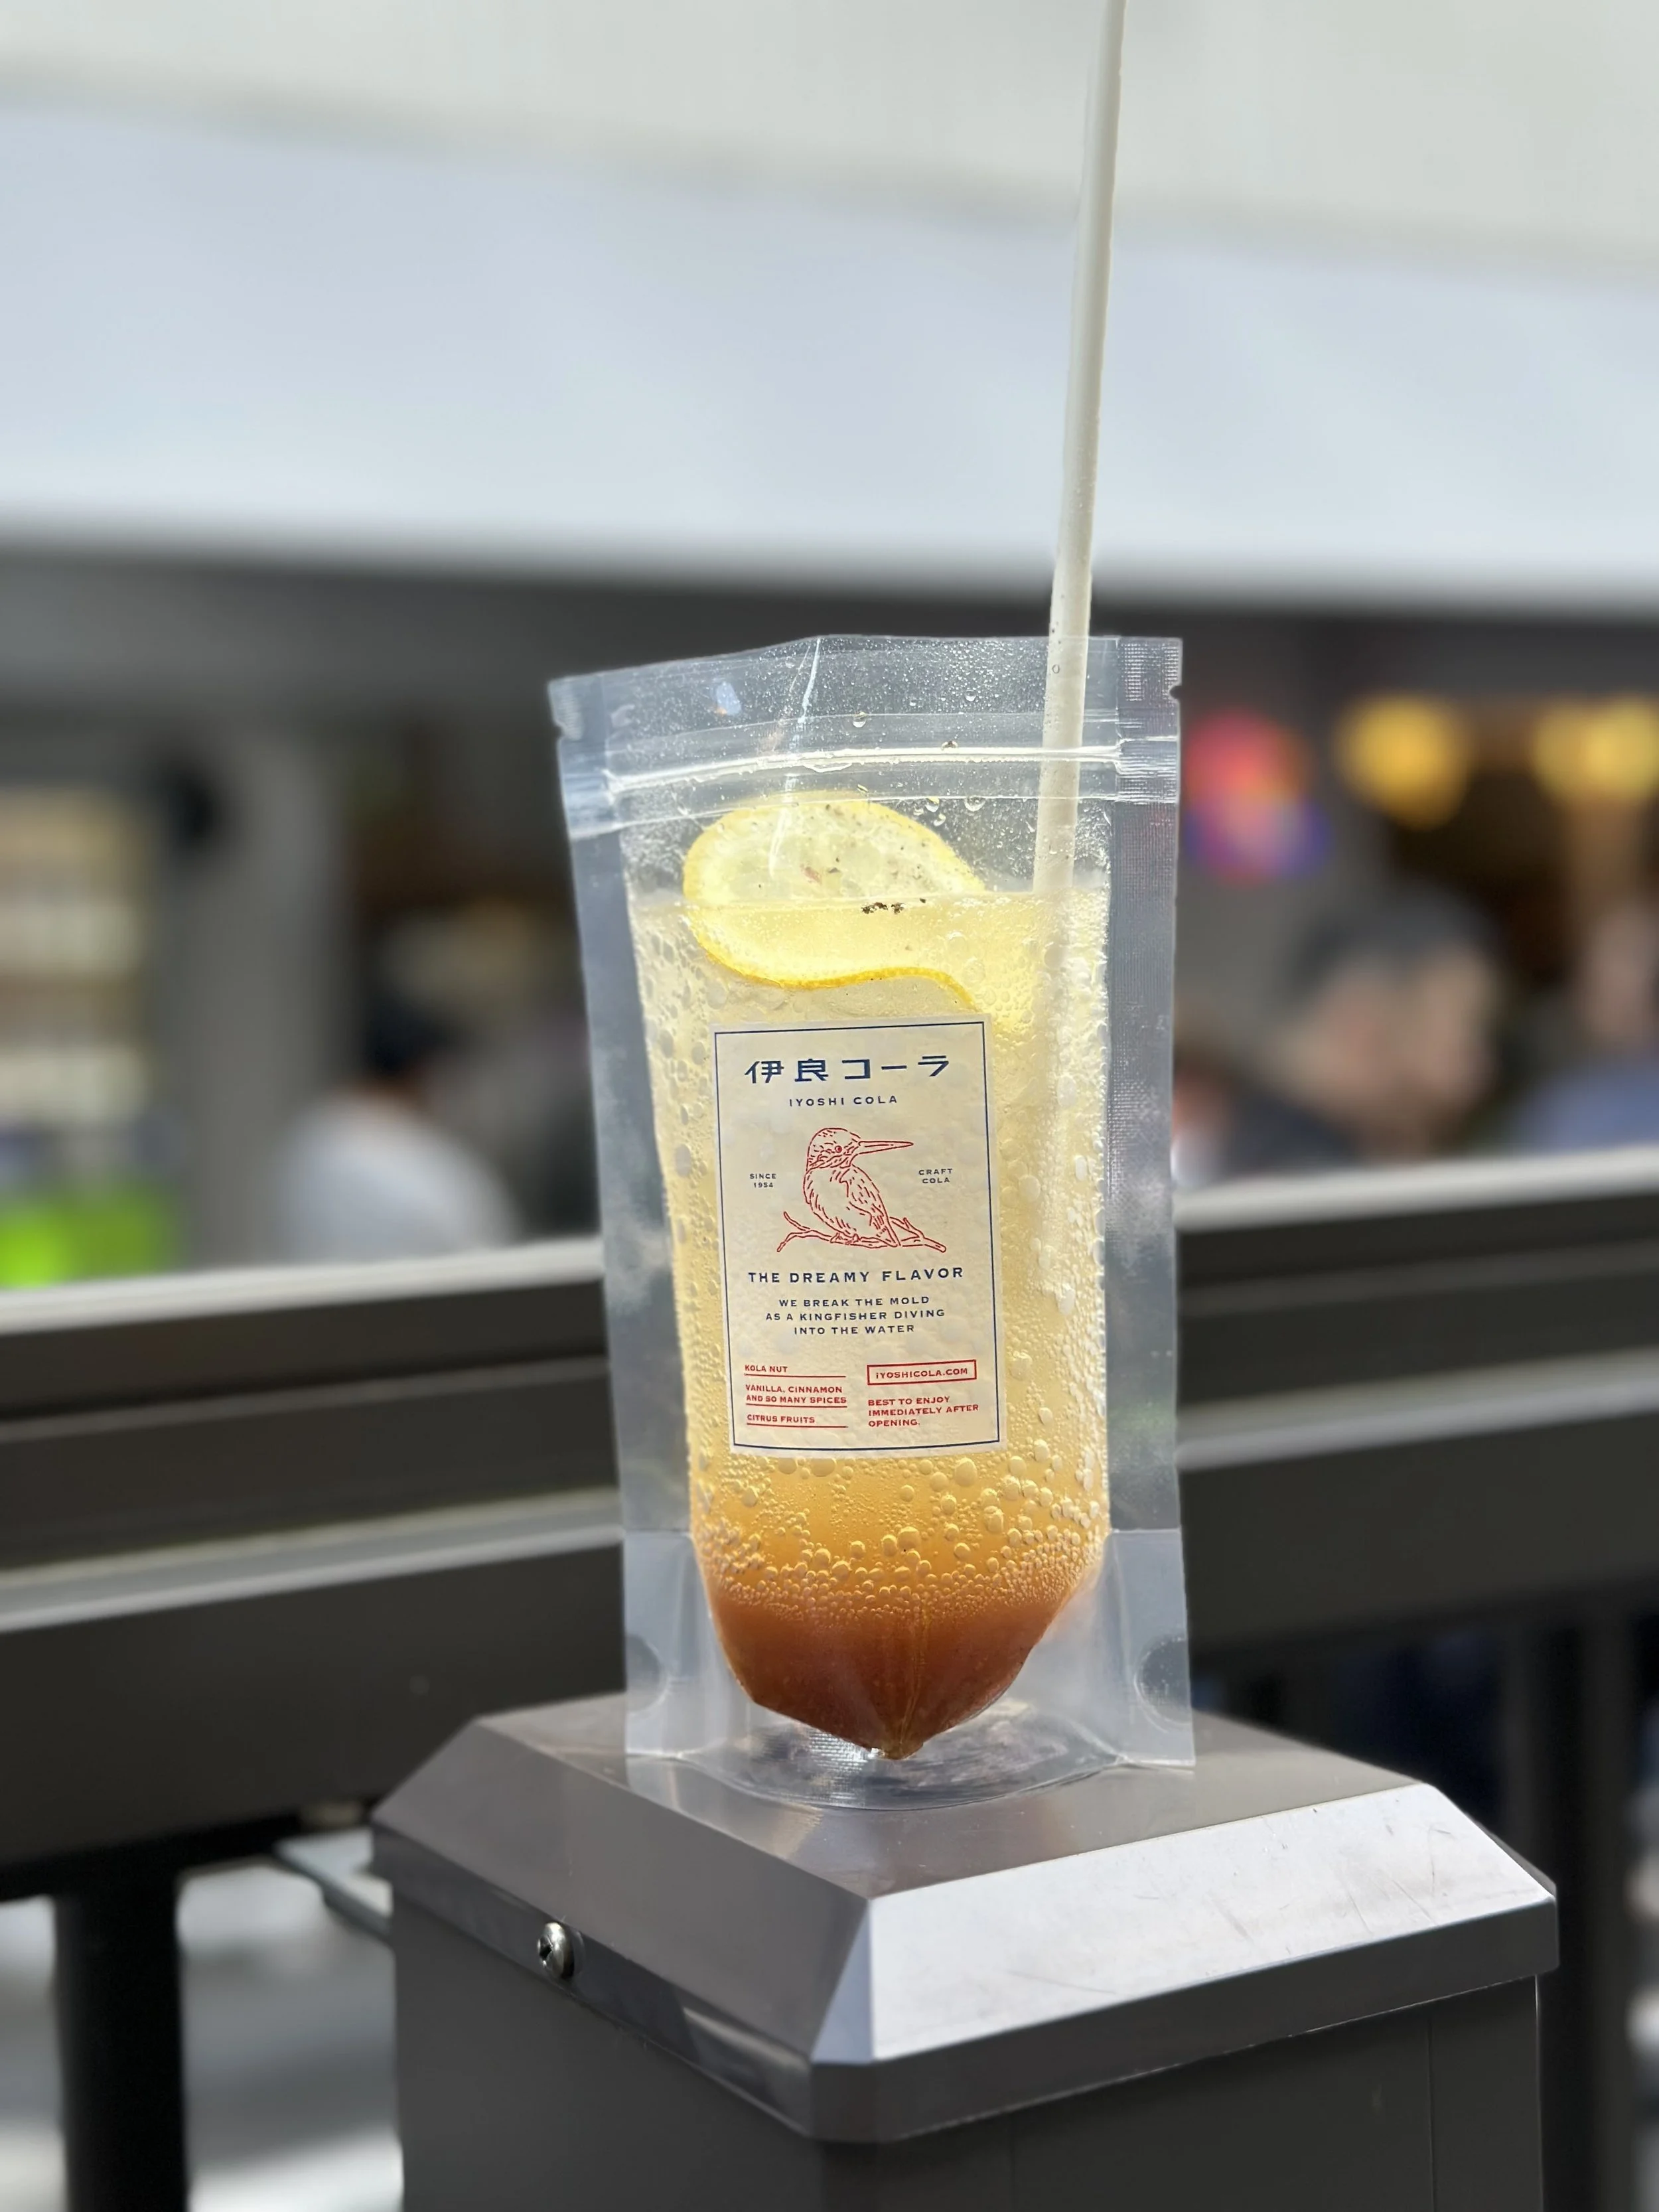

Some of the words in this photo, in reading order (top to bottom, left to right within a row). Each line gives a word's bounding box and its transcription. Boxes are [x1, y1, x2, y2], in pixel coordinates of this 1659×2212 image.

[744, 1055, 950, 1084] 伊良コーラ
[789, 1097, 844, 1107] IYOSHI
[853, 1095, 897, 1105] COLA
[748, 1272, 780, 1283] THE
[790, 1271, 869, 1283] DREAMY
[882, 1267, 963, 1282] FLAVOR
[804, 1299, 849, 1307] BREAK
[890, 1296, 929, 1305] MOLD
[800, 1311, 887, 1321] KINGFISHER
[894, 1309, 945, 1319] DIVING
[864, 1325, 914, 1334] WATER
[916, 1396, 950, 1404] ENJOY
[869, 1406, 942, 1417] IMMEDIATELY
[946, 1404, 979, 1413] AFTER
[747, 1414, 778, 1422] CITRUS
[868, 1418, 920, 1428] OPENING.
